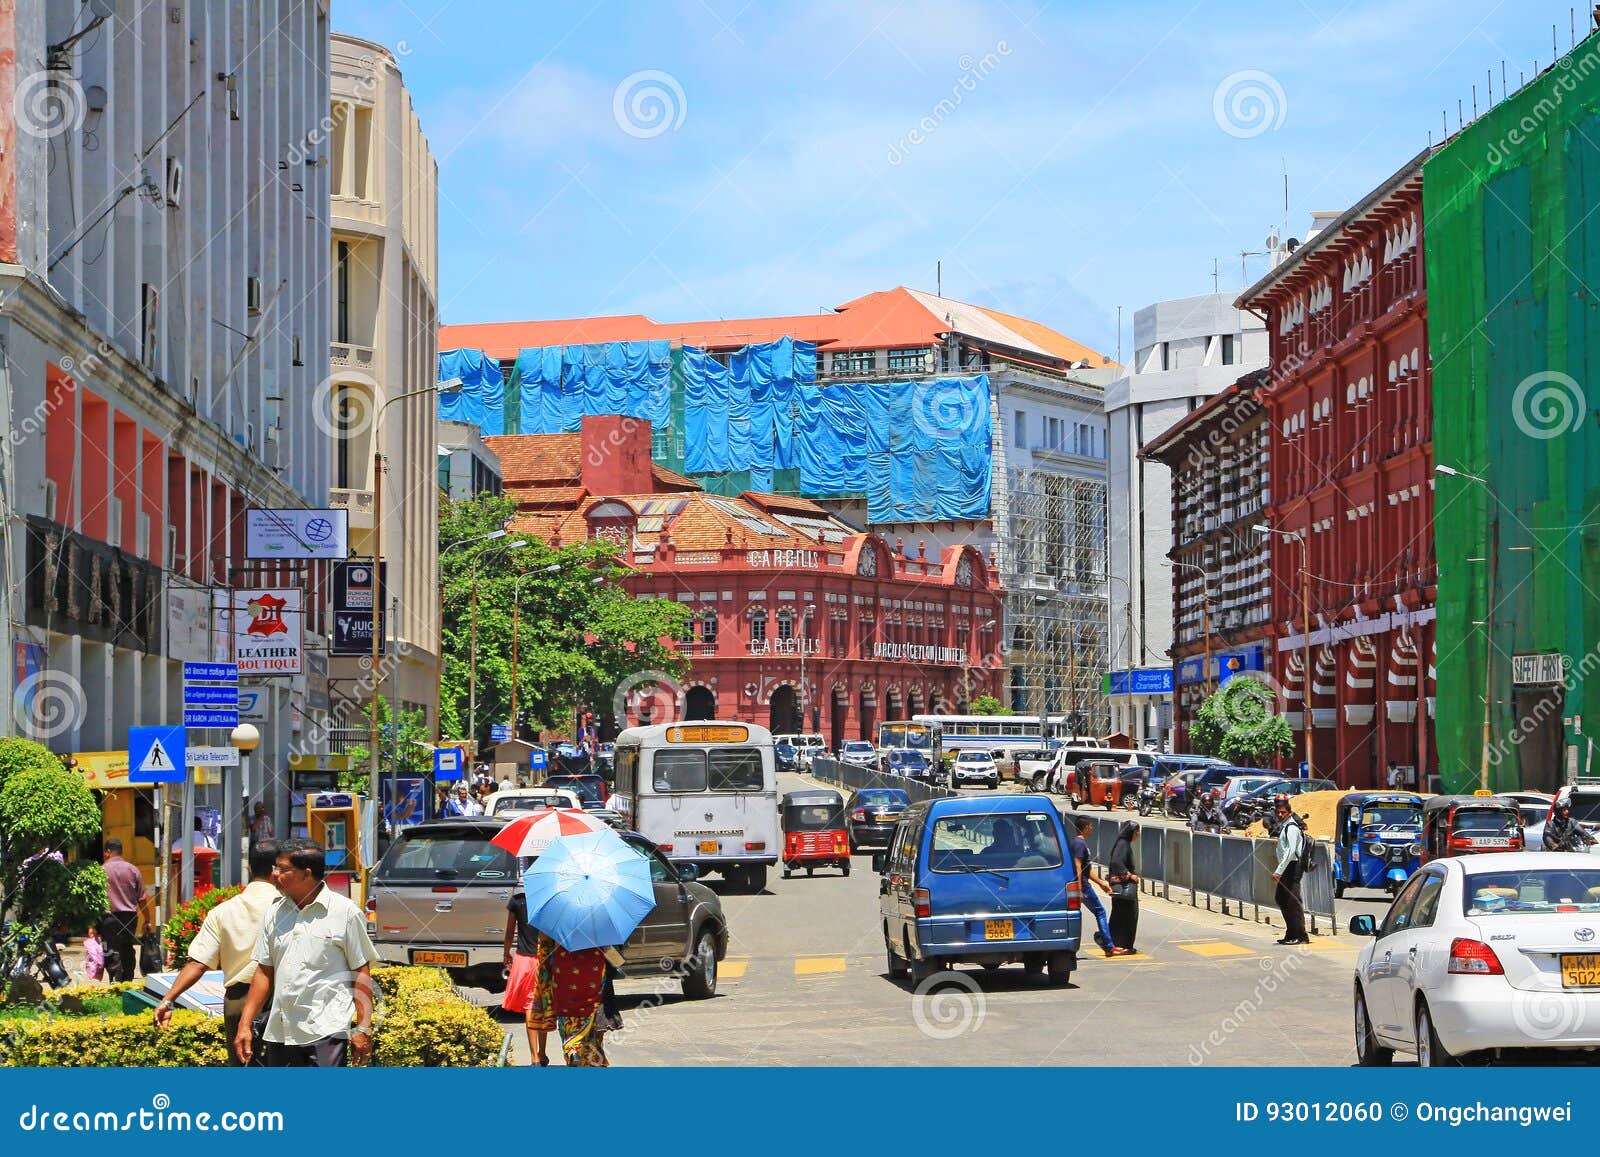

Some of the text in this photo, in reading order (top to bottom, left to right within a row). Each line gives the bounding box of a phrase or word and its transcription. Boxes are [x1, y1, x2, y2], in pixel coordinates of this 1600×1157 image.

[751, 549, 819, 568] CARGILLS
[352, 620, 381, 631] JUIC
[751, 638, 820, 654] CARGILLS
[237, 647, 297, 658] LEATHER
[237, 659, 297, 670] BOUTIQUE
[1514, 655, 1560, 682] SAFETY FIRST
[1137, 673, 1162, 681] Standard
[1135, 682, 1162, 690] Chartered
[194, 752, 208, 761] Lanka
[209, 752, 229, 761] Telecom
